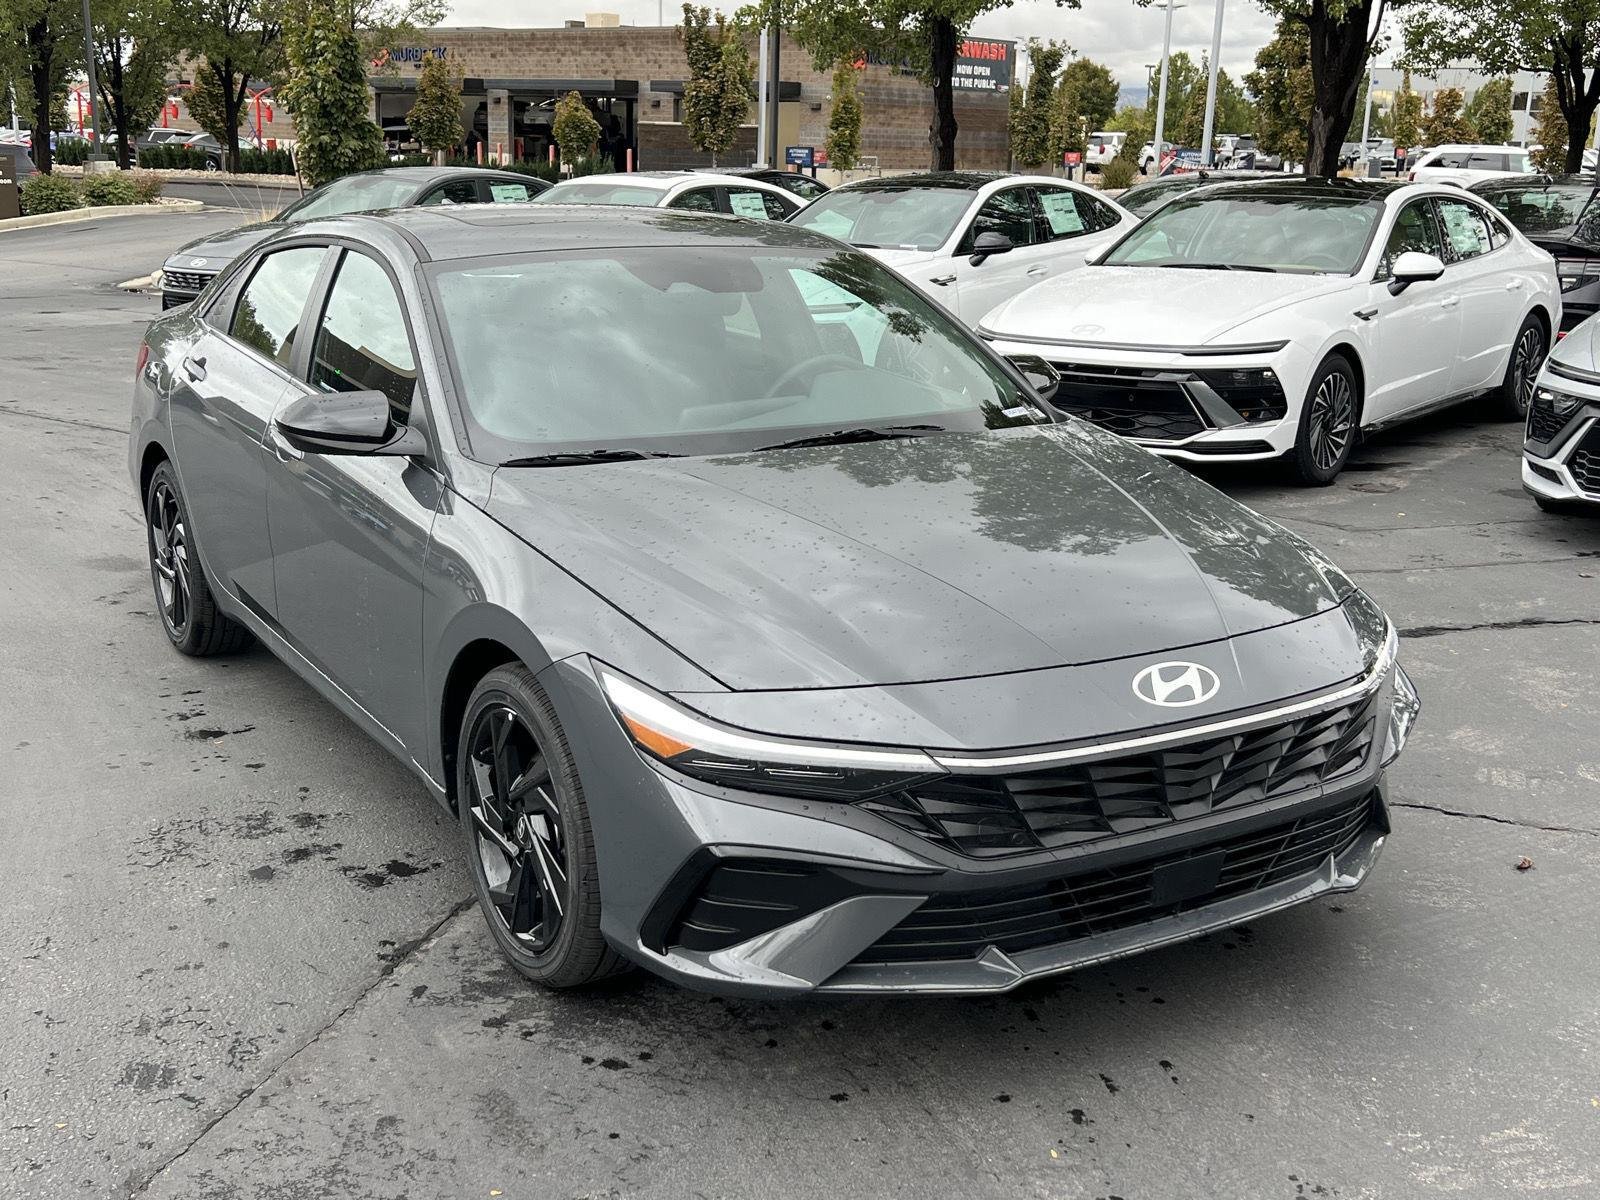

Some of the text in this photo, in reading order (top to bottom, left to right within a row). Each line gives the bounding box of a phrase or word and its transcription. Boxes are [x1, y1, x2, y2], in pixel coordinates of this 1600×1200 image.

[391, 47, 447, 62] MURDK
[957, 40, 1007, 61] RWASH
[956, 64, 991, 76] NOW OPEN
[951, 77, 960, 87] TO
[960, 78, 973, 88] THE
[973, 79, 997, 90] PUBLIC
